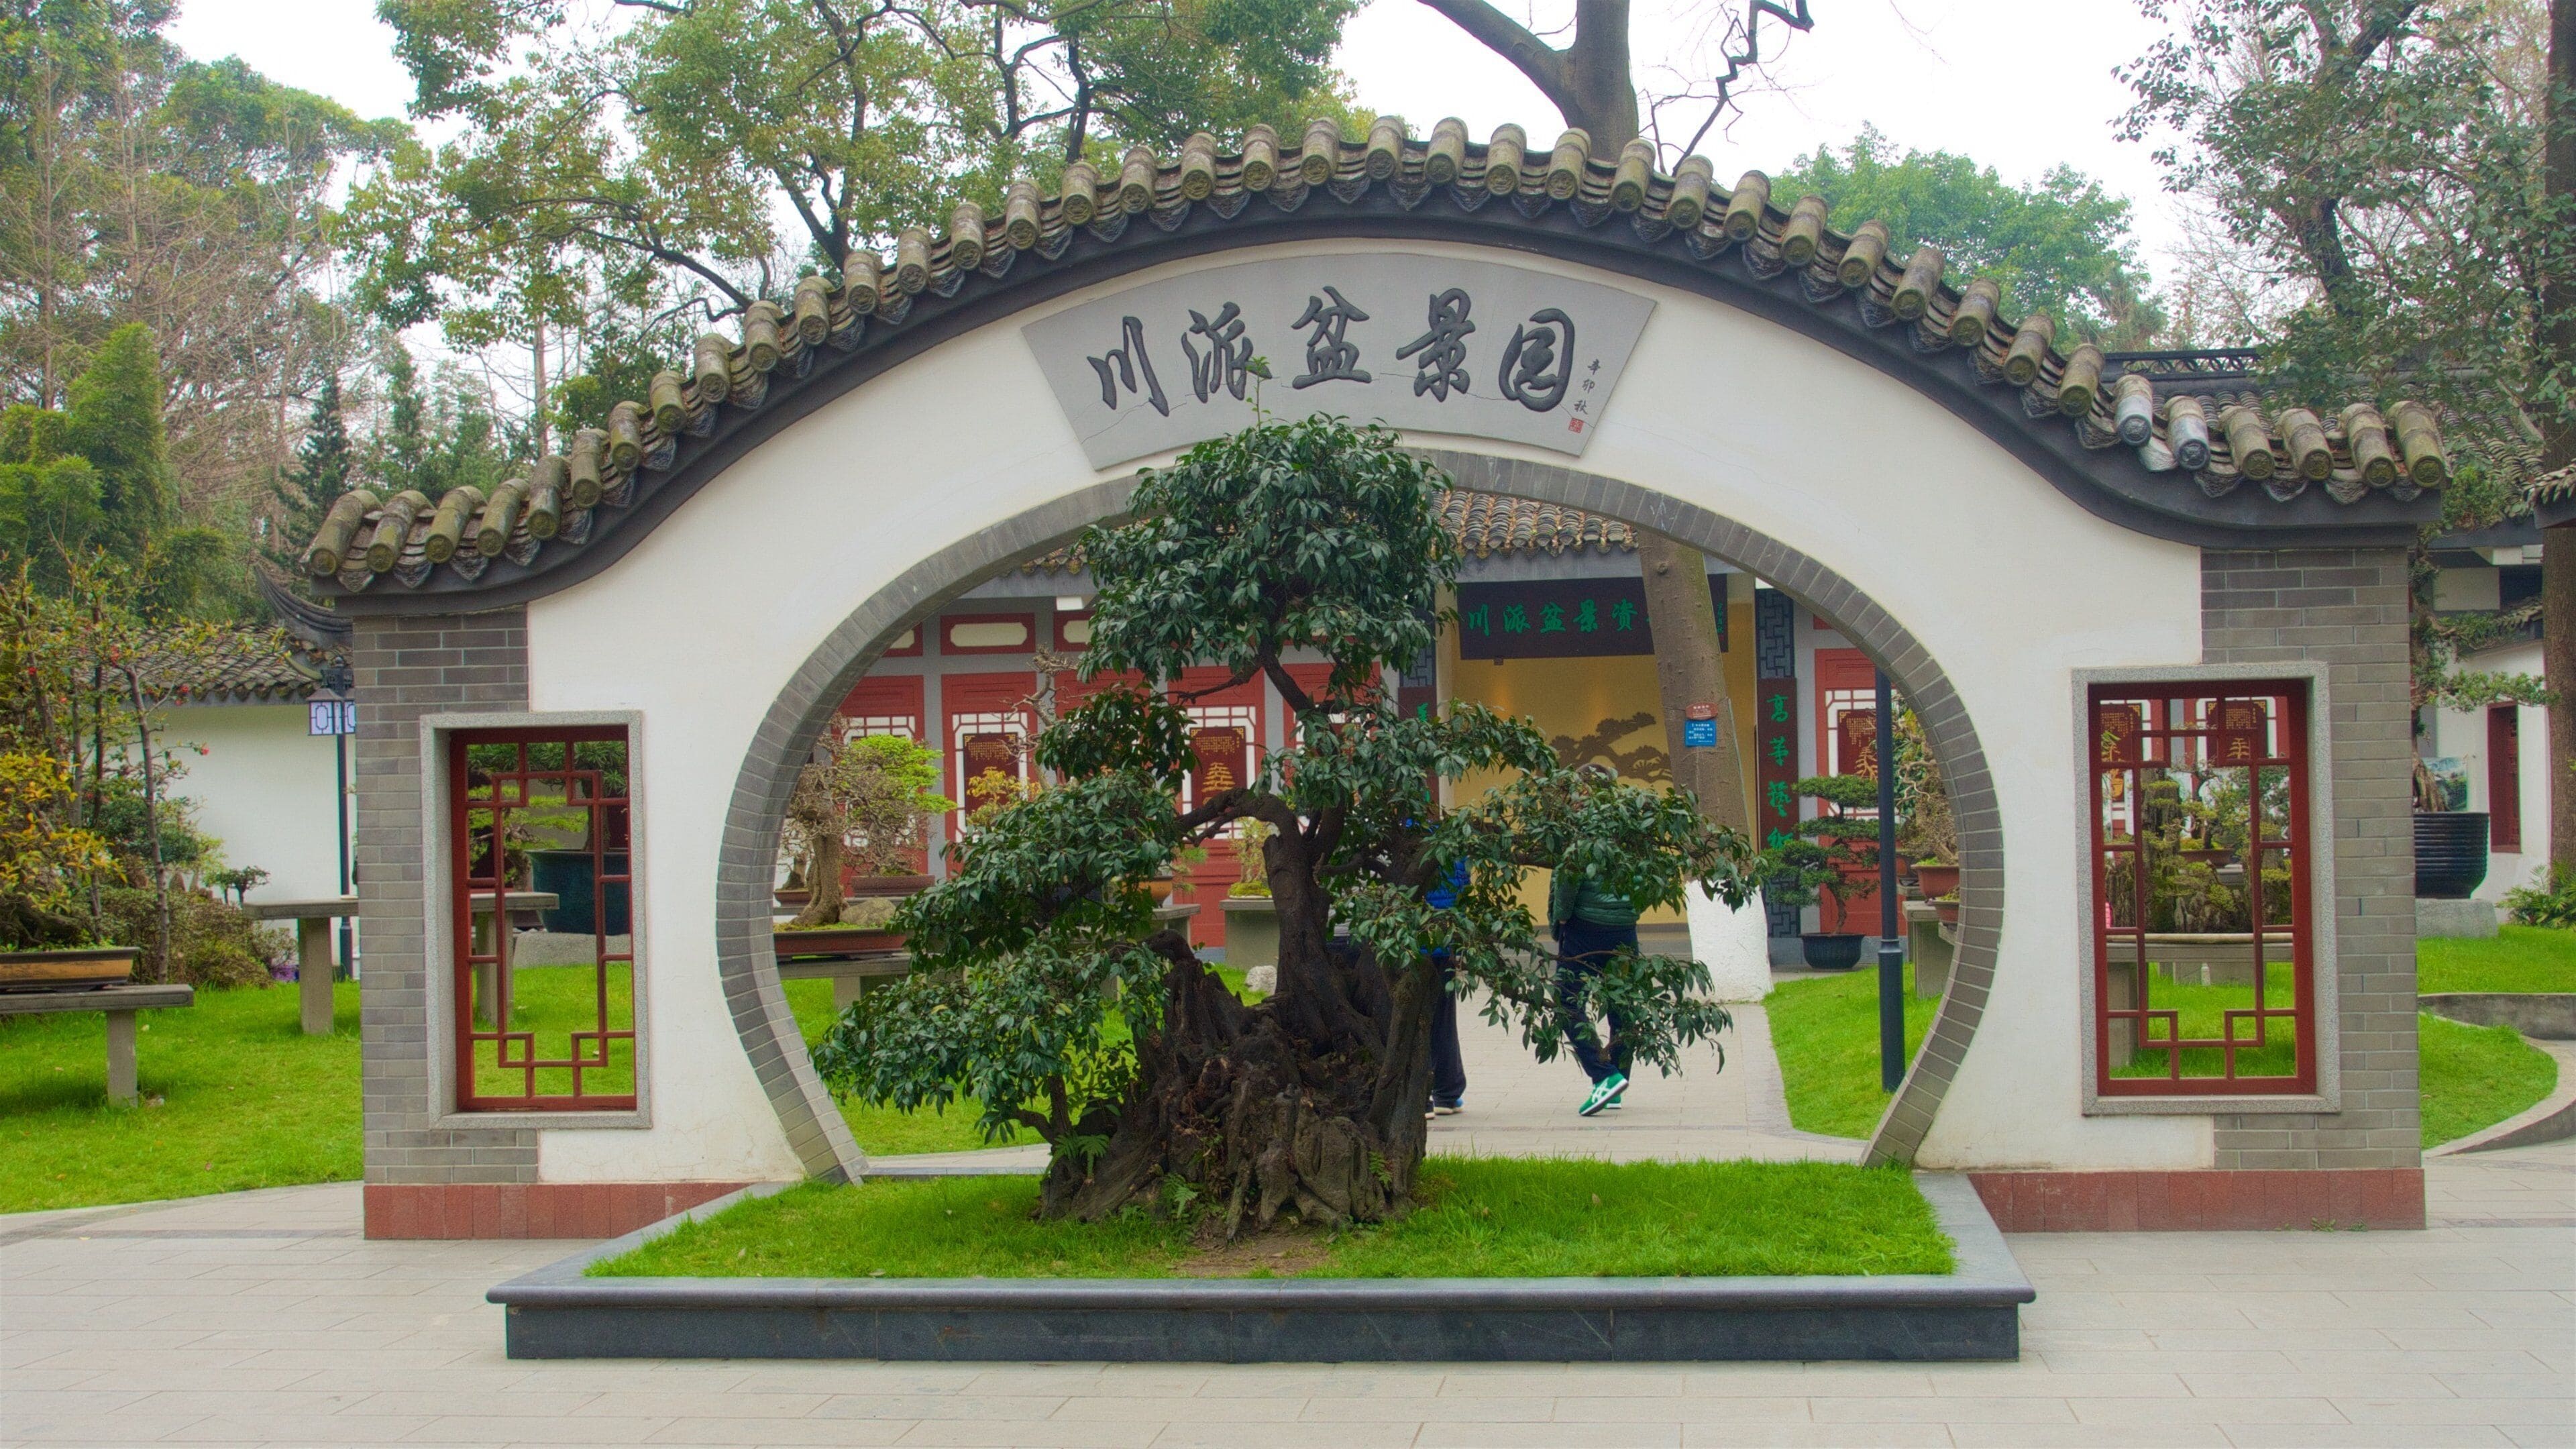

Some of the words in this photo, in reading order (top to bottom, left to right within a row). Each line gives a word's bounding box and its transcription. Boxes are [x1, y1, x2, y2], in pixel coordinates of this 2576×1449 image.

[1468, 598, 1652, 637] 川派盆景资
